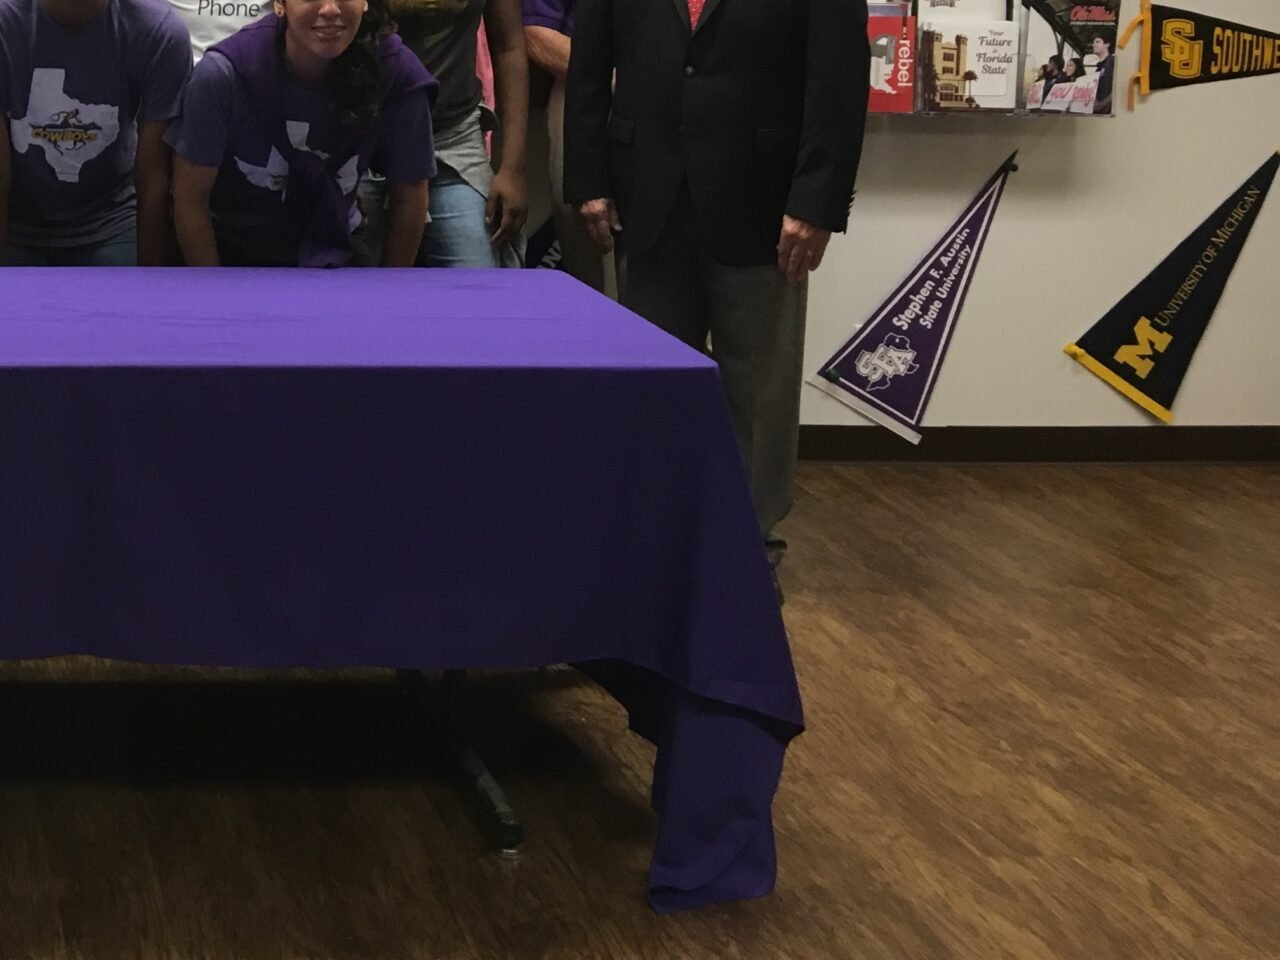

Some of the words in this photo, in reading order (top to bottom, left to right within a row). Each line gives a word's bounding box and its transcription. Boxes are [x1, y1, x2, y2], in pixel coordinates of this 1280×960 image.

[898, 39, 913, 87] rebel
[976, 53, 1013, 64] Florida
[978, 36, 1013, 47] Future
[982, 64, 1007, 75] State
[892, 277, 936, 330] Stephen
[933, 266, 944, 282] F.
[939, 227, 970, 268] Austin
[1154, 264, 1207, 327] UNIVERSITY
[1202, 244, 1218, 263] OF
[1214, 186, 1261, 248] MICHIGAN
[919, 297, 943, 330] State
[935, 244, 971, 297] University
[1113, 316, 1174, 379] M
